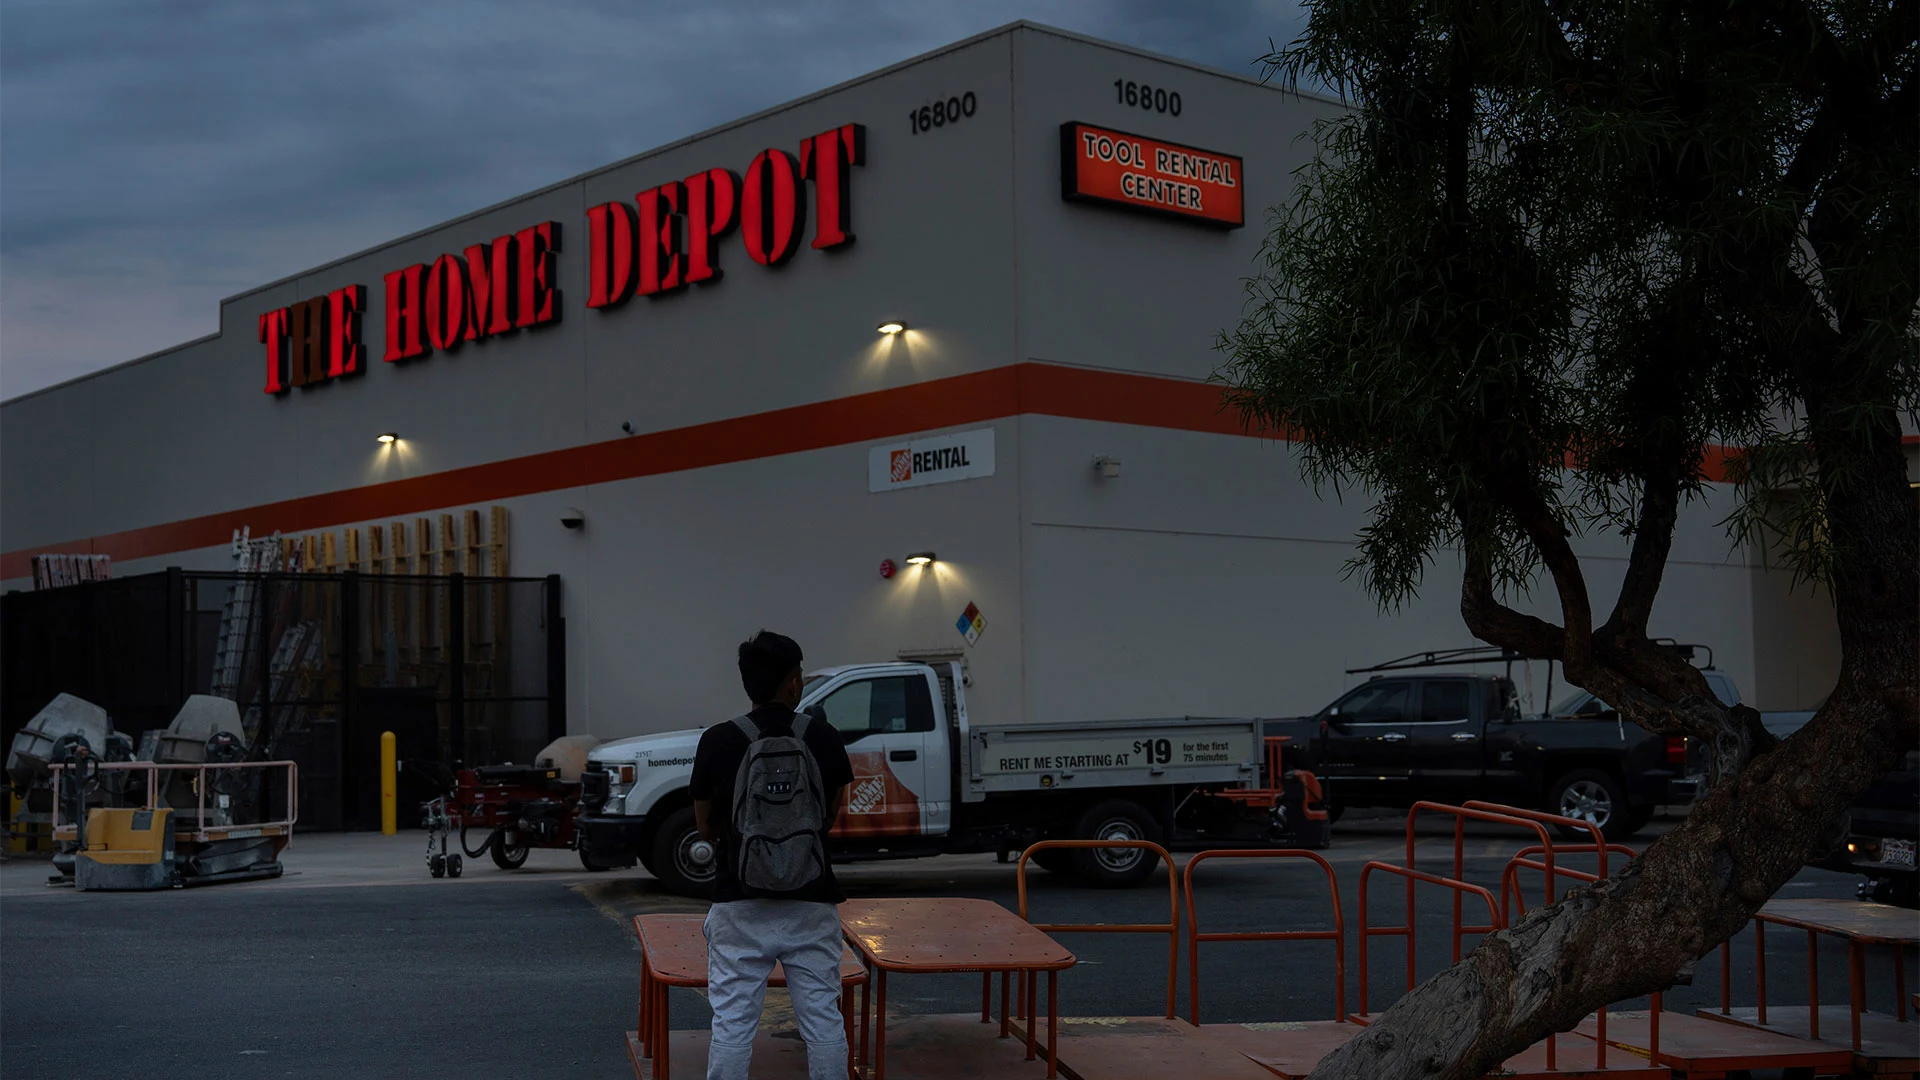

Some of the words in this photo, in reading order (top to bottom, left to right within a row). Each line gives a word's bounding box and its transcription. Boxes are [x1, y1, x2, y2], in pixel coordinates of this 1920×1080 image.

[909, 91, 977, 134] 16800
[1114, 79, 1182, 117] 16800
[1083, 132, 1145, 168] TOOL
[1156, 149, 1236, 187] RENTAL
[1121, 173, 1203, 211] CENTER
[258, 284, 367, 395] THE
[384, 220, 563, 363] HOME
[587, 123, 866, 310] DEPOT
[913, 445, 970, 474] RENTAL
[1000, 757, 1030, 770] RENT
[1034, 756, 1052, 769] ME
[1055, 754, 1112, 768] STARTING
[1115, 754, 1130, 765] AT
[1133, 739, 1172, 764] $19
[1183, 742, 1195, 751] for
[1196, 742, 1210, 751] the
[1212, 741, 1229, 750] first
[1183, 753, 1193, 762] 75
[1195, 752, 1228, 761] minutes
